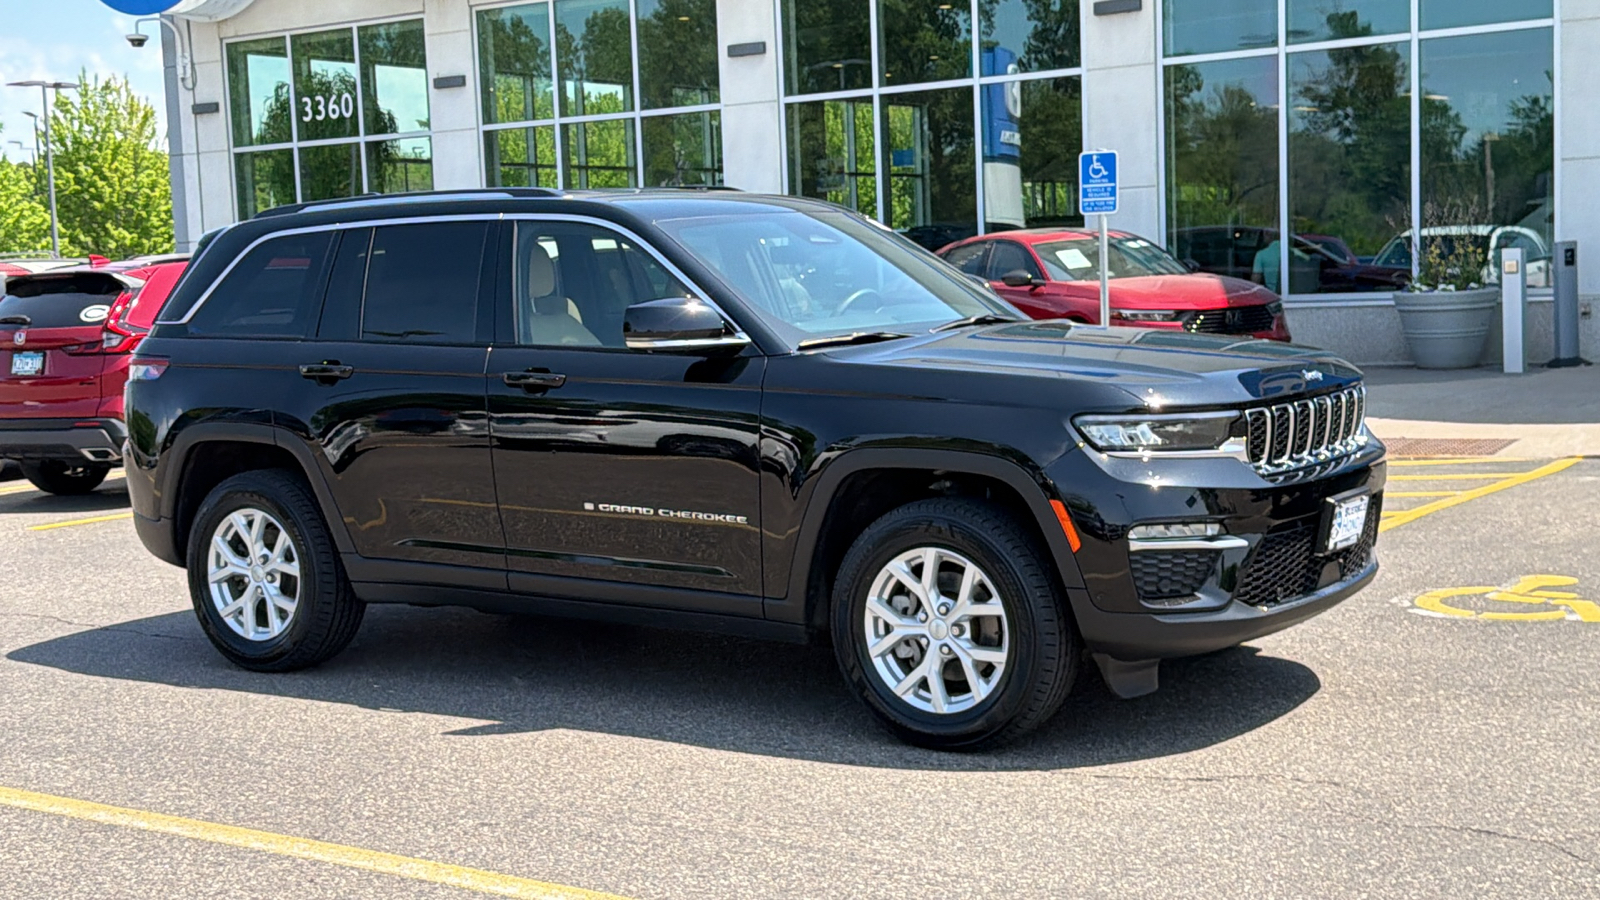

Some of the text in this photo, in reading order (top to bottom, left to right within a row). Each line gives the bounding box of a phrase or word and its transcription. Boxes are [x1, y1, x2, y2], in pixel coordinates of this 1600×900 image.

[302, 93, 353, 122] 3360
[598, 503, 748, 524] GRAND CHEROKEE
